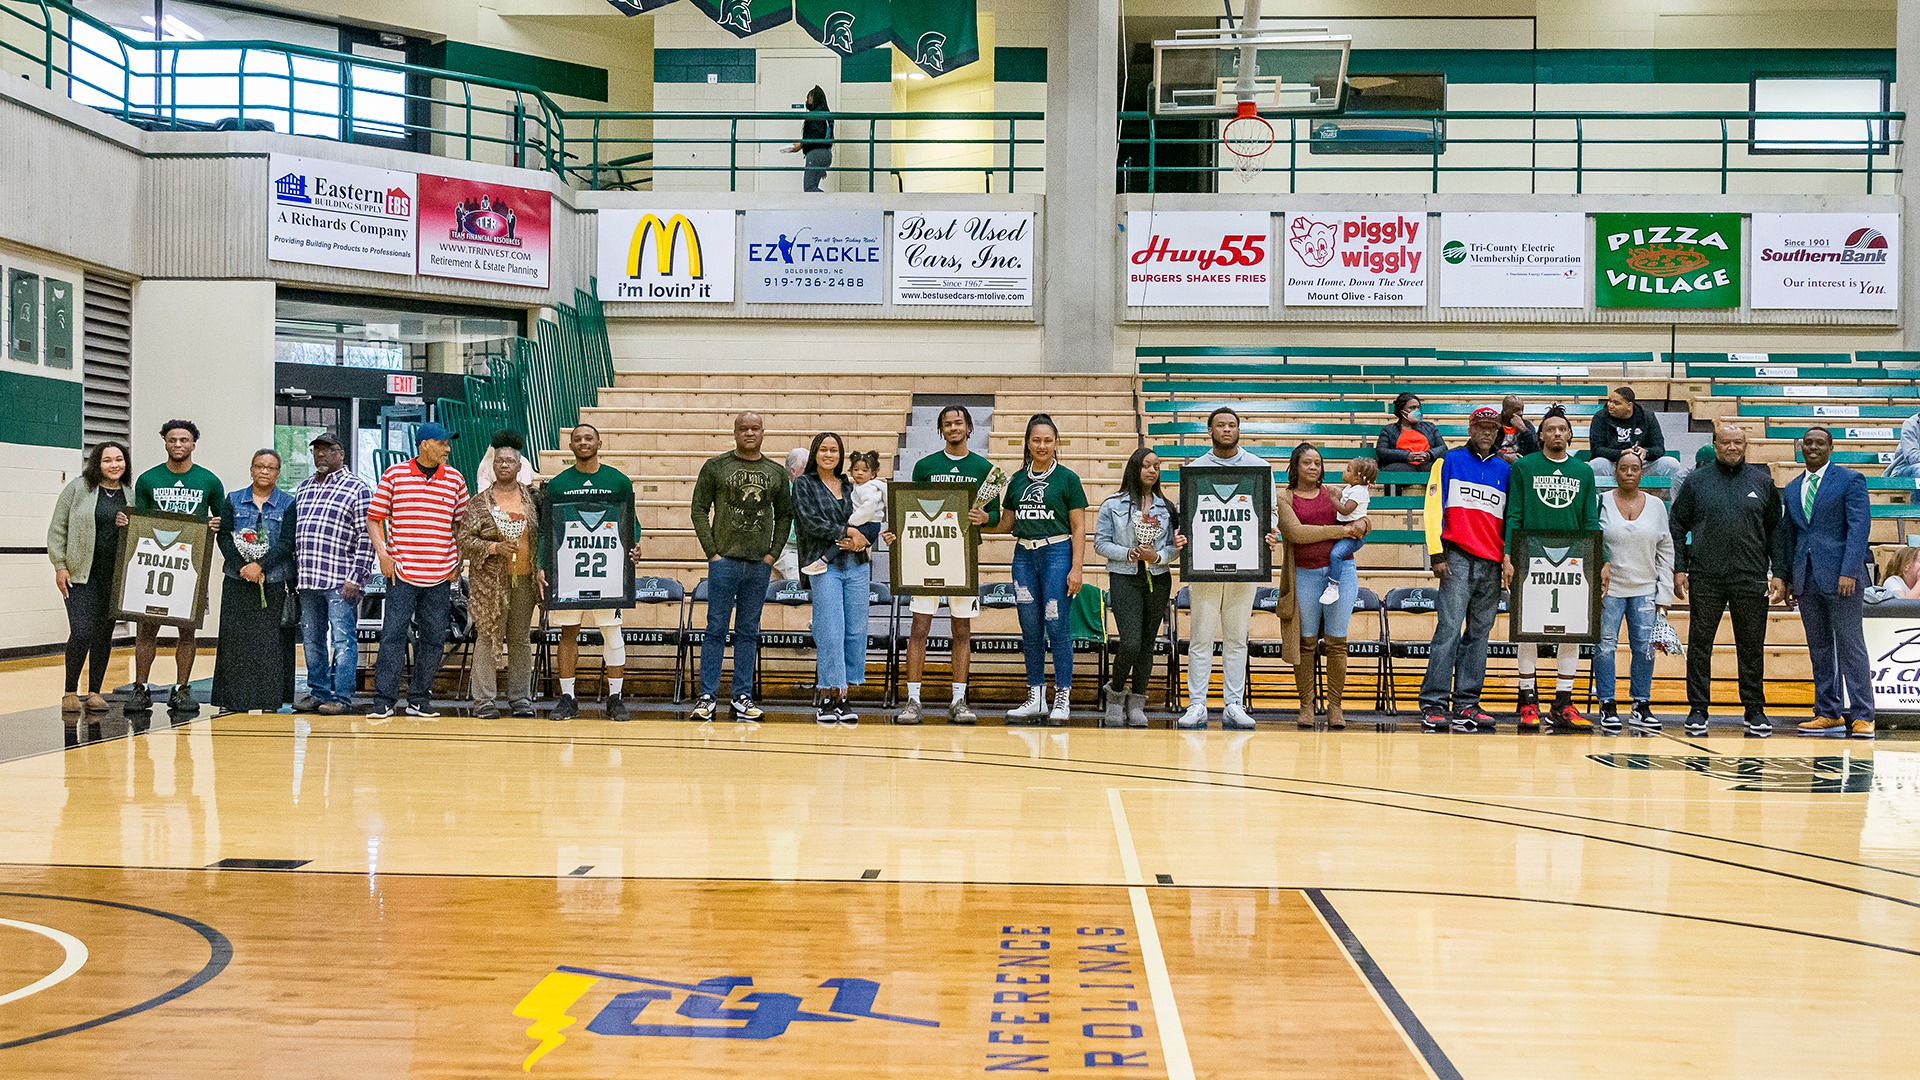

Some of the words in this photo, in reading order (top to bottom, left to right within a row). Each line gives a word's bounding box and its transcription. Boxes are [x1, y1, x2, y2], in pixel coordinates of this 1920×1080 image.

[315, 177, 384, 204] Eastern
[315, 198, 353, 210] BUILDING
[354, 202, 383, 213] SUPPLY
[387, 196, 409, 215] EBS
[277, 211, 288, 223] A
[291, 212, 346, 231] Richards
[350, 220, 408, 241] Company
[477, 217, 497, 229] TFR
[899, 216, 958, 240] Best
[964, 216, 1028, 241] Used
[1343, 216, 1420, 244] piggly
[273, 235, 304, 247] Providing
[305, 239, 332, 250] Building
[333, 242, 361, 253] Products
[369, 247, 411, 258] Professionals
[451, 231, 465, 240] TEAM
[466, 233, 492, 242] FINANCIAL
[494, 236, 521, 246] RESOURCES
[1607, 226, 1729, 251] PIZZA
[439, 243, 532, 261] WWW.TFRINVEST.COM
[749, 244, 778, 262] EZ
[797, 244, 879, 262] TACKLE
[1470, 243, 1518, 254] Tri-County
[1521, 243, 1555, 252] Electric
[430, 254, 472, 268] Retirement
[475, 259, 481, 269] &
[483, 260, 505, 272] Estate
[507, 263, 538, 278] Planning
[905, 243, 962, 273] Cars,
[971, 244, 1022, 269] Inc.
[1341, 245, 1422, 274] wiggly
[1470, 254, 1525, 264] Membership
[1527, 254, 1581, 264] Corporation
[764, 278, 864, 287] 919-736-2488
[1131, 274, 1182, 283] BURGERS
[1186, 274, 1231, 283] SHAKES
[1235, 274, 1266, 283] FRIES
[1288, 278, 1314, 286] Down
[1316, 278, 1346, 287] Home,
[1348, 278, 1375, 286] Down
[1378, 278, 1395, 286] The
[1397, 278, 1424, 287] Street
[1606, 269, 1730, 293] VILLAGE
[1783, 277, 1804, 287] Our
[1808, 278, 1845, 287] interest
[1849, 278, 1857, 287] is
[1860, 281, 1886, 294] You.
[618, 283, 643, 297] i'm
[649, 283, 695, 298] lovin'
[699, 283, 711, 297] it
[901, 292, 1025, 300] www.bestusedcars-mtolive.com
[1307, 292, 1339, 301] Mount
[1341, 292, 1365, 301] Olive
[1374, 292, 1403, 301] Faison
[394, 376, 413, 392] EXIT
[1533, 476, 1560, 484] MOUNT
[1560, 476, 1581, 487] OLIVE
[153, 488, 180, 496] MOUNT
[181, 489, 203, 497] OLIVE
[1460, 487, 1500, 505] POLO
[1015, 510, 1055, 520] MOM
[1200, 509, 1251, 522] TROJANS
[907, 525, 957, 539] TROJANS
[1209, 525, 1242, 551] 33
[567, 536, 617, 549] TROJANS
[137, 552, 190, 571] TROJANS
[926, 541, 941, 566] 0
[575, 552, 607, 577] 22
[145, 570, 174, 596] 10
[1531, 572, 1582, 585] TROJANS
[1551, 588, 1559, 613] 1
[762, 635, 804, 643] TROJANS
[975, 641, 1019, 649] TROJANS
[1875, 684, 1920, 696] uality
